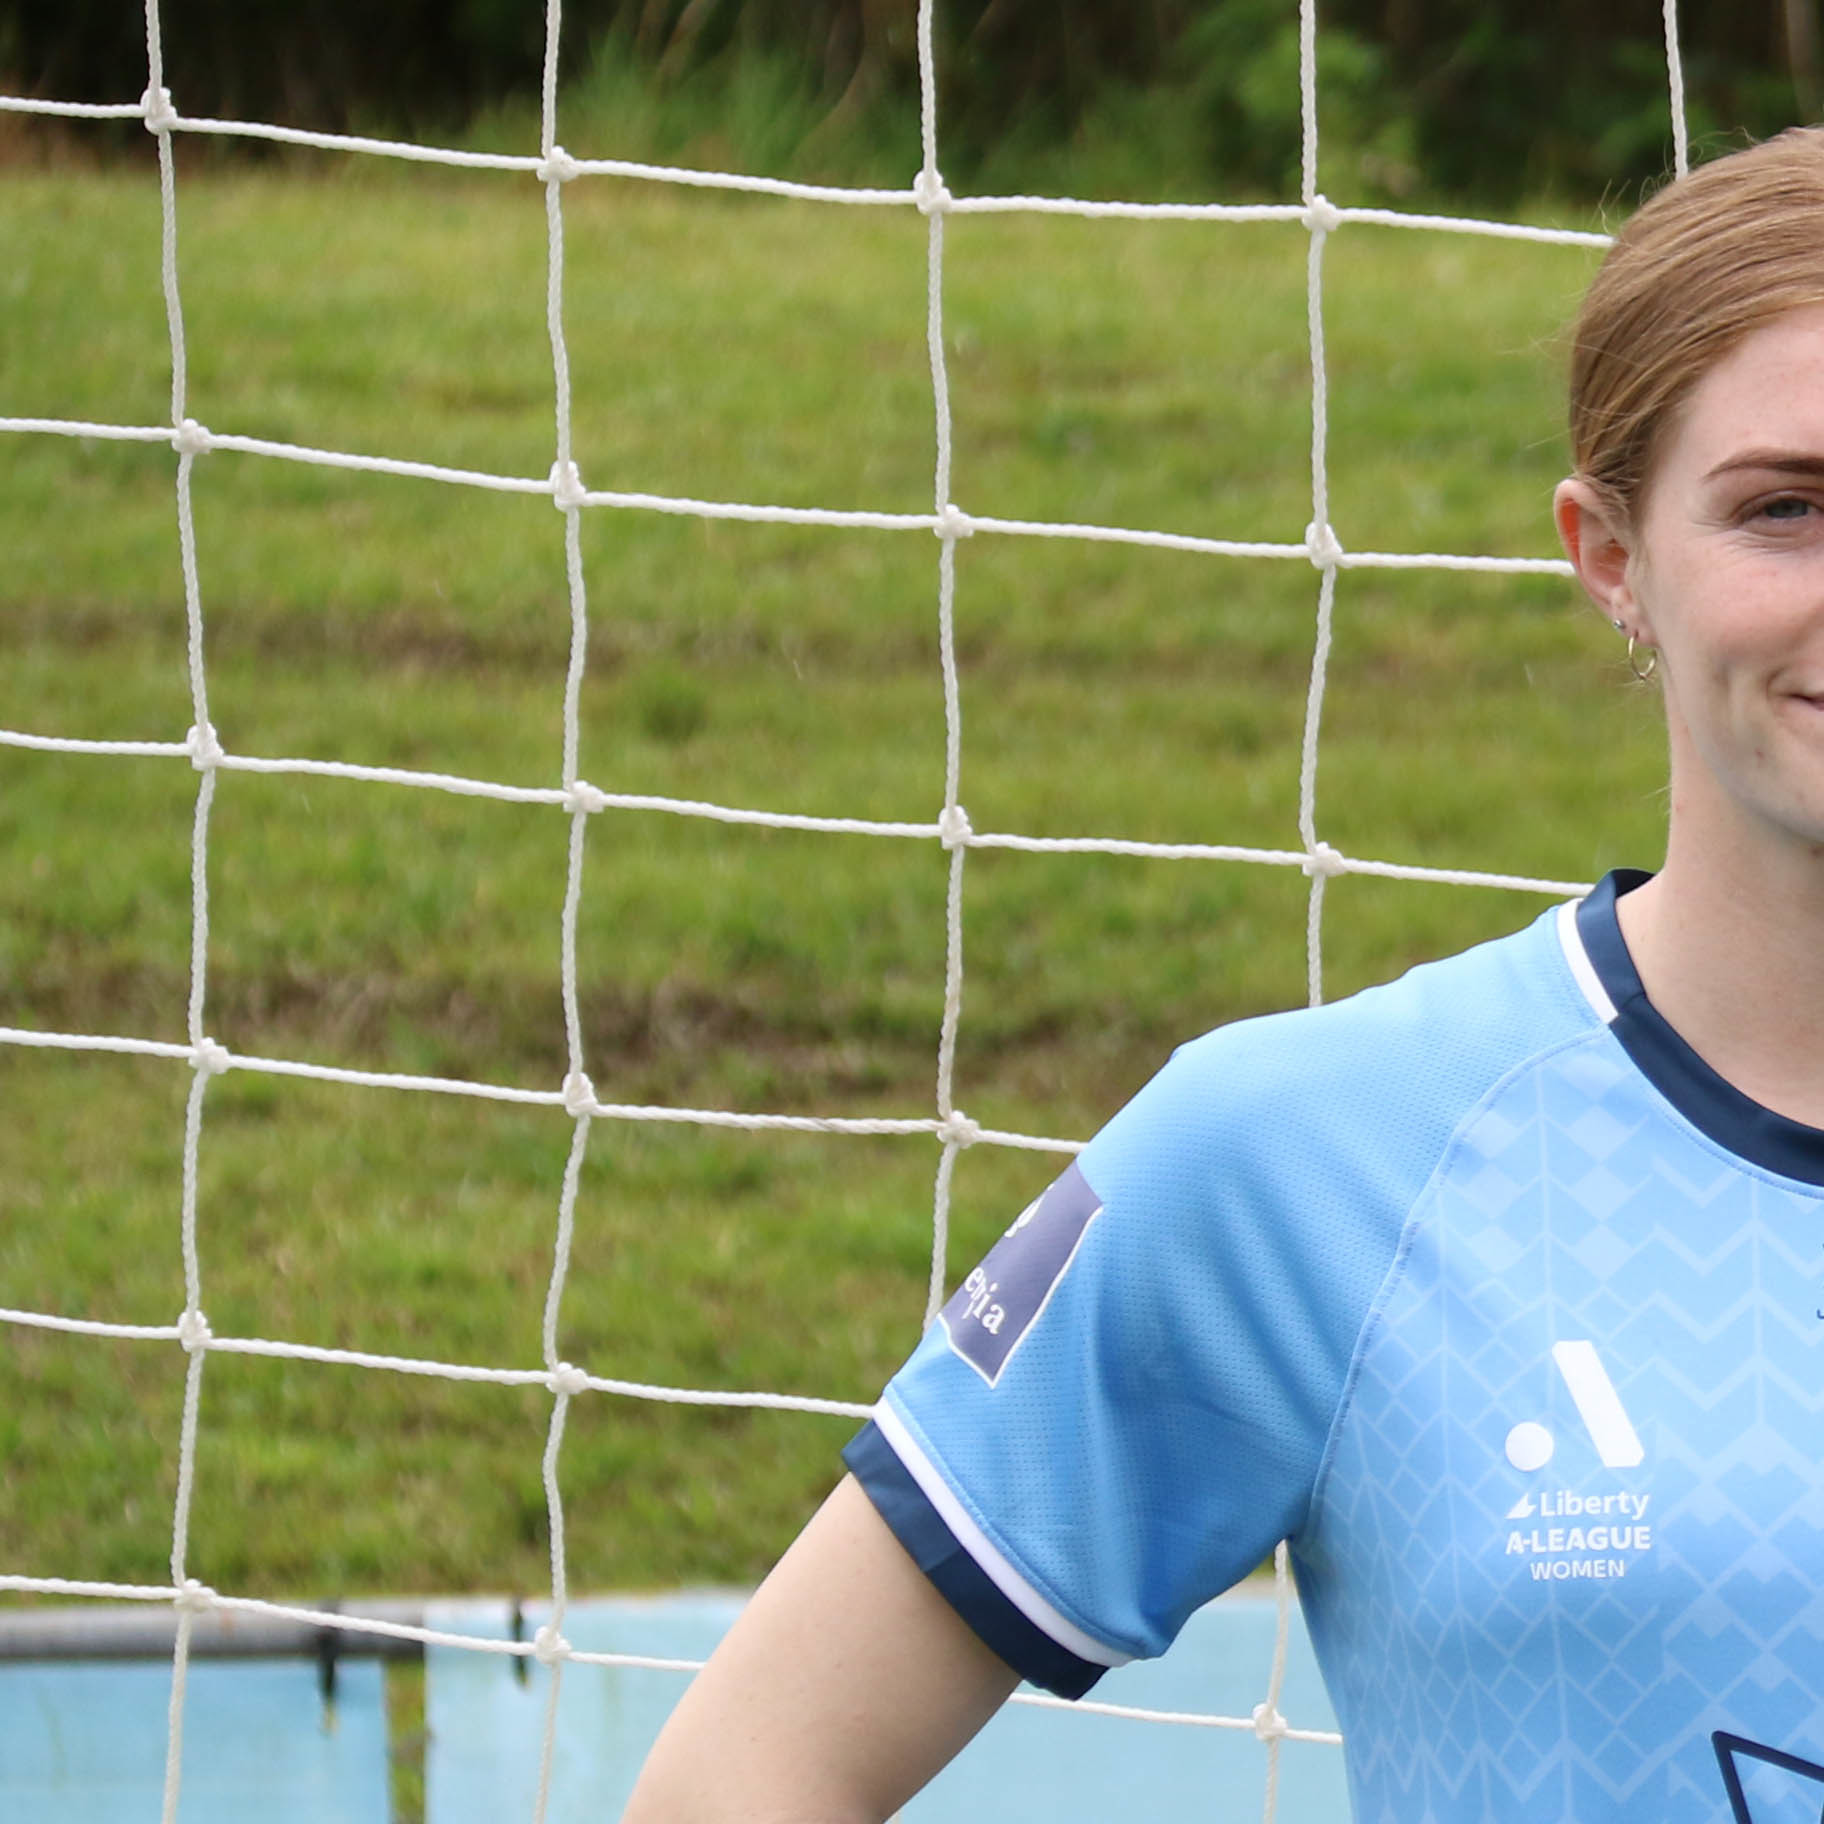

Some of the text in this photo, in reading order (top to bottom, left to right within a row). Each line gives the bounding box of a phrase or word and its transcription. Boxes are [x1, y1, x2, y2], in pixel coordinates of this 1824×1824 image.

[1540, 1490, 1650, 1521] Liberty
[1504, 1525, 1652, 1556] A-LEAGUE
[1529, 1559, 1625, 1581] WOMEN
